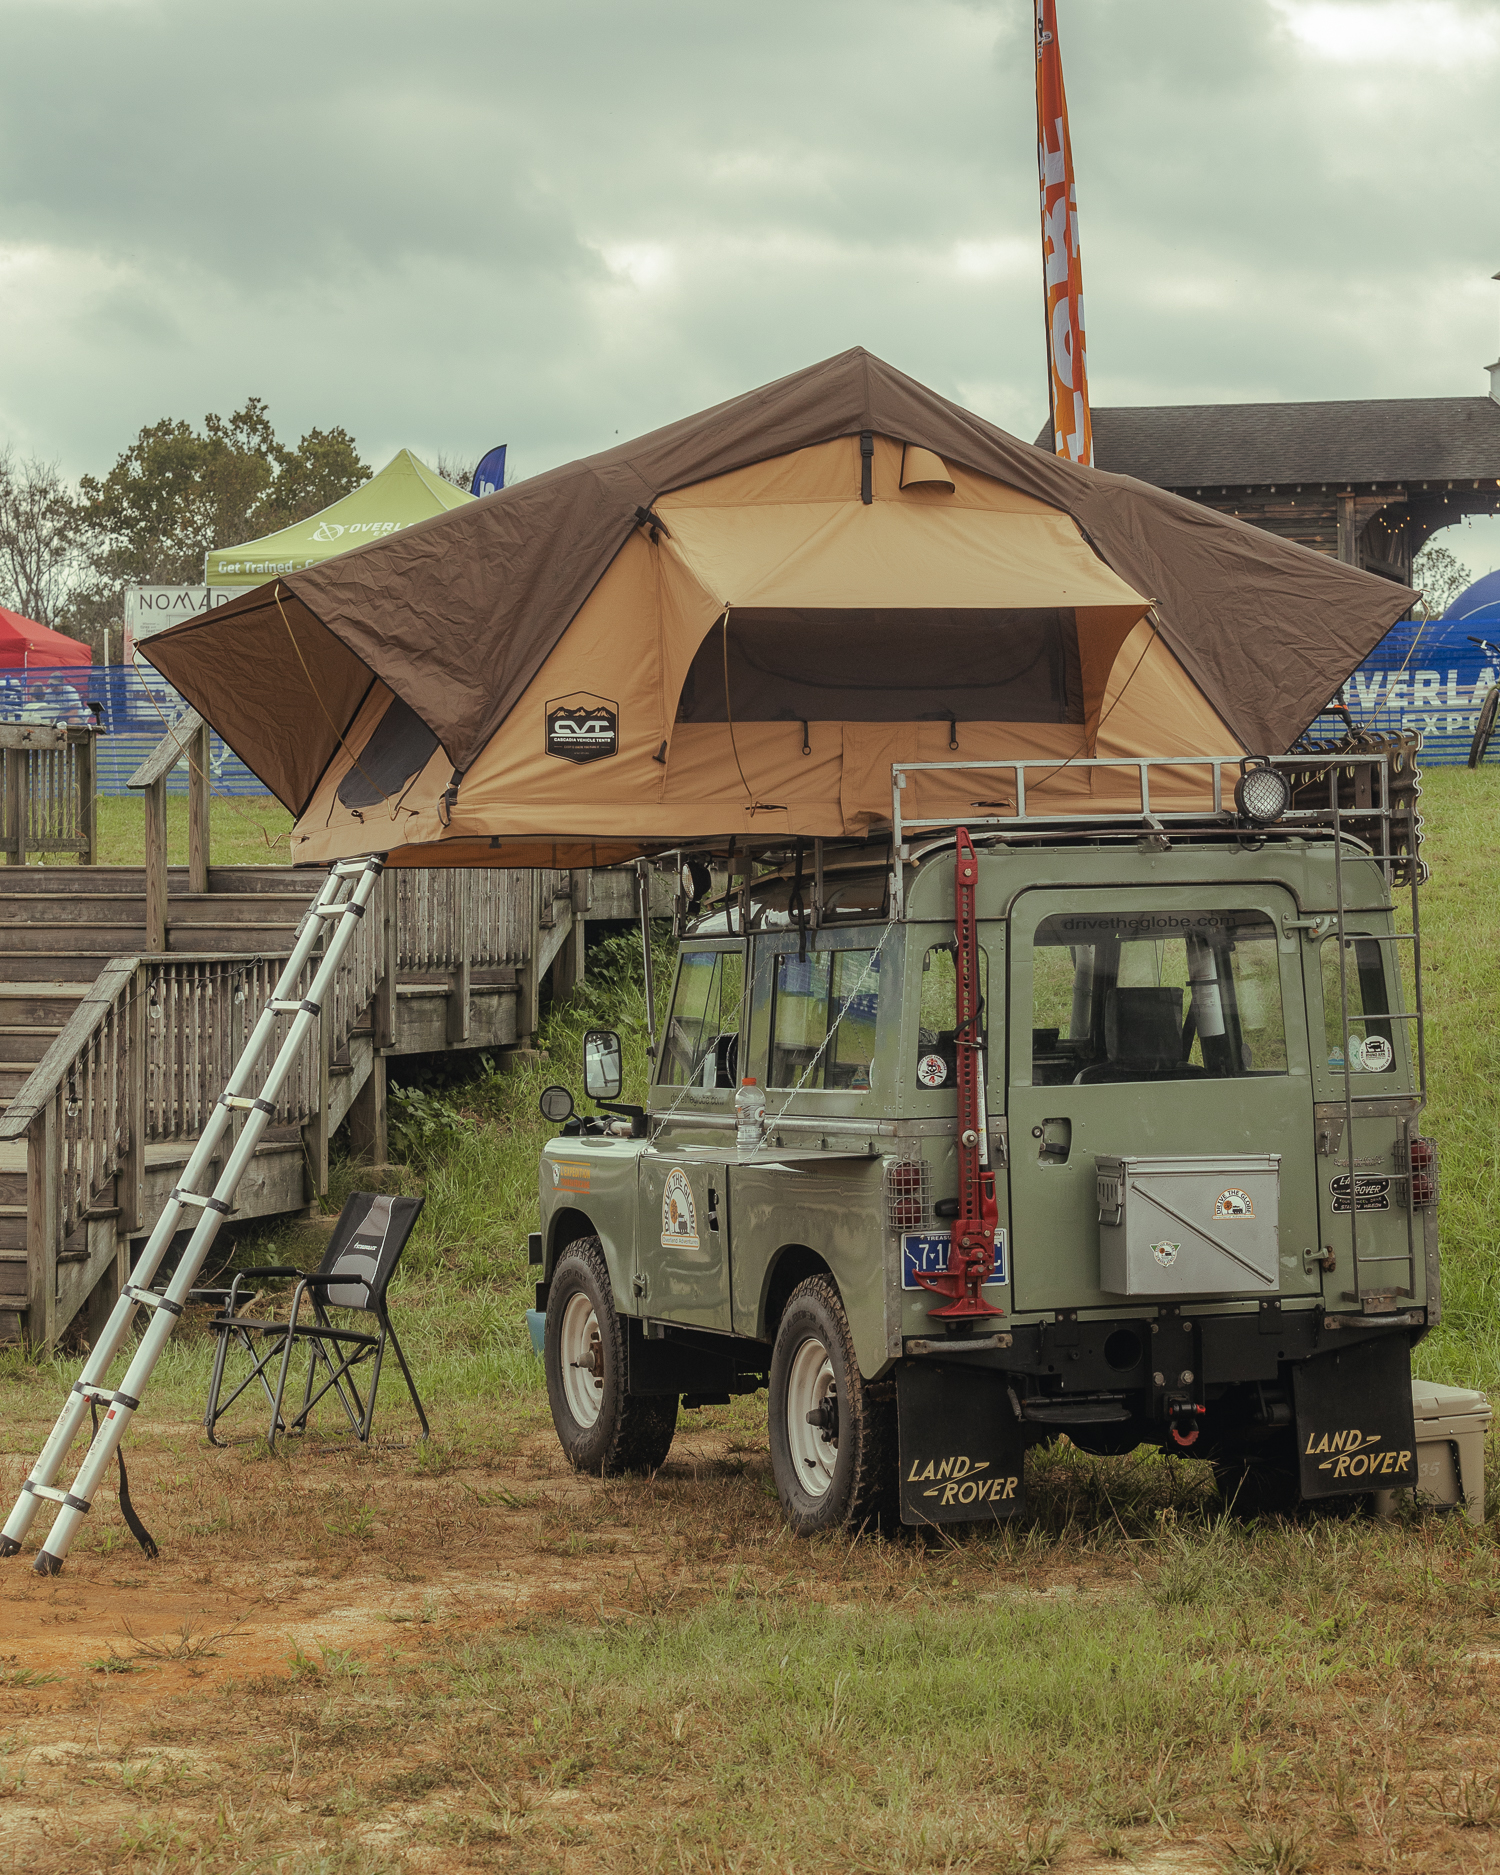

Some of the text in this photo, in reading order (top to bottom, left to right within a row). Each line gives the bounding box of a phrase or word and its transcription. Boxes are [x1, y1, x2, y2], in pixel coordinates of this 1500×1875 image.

[349, 522, 414, 534] OVERL
[218, 561, 241, 573] Get
[244, 560, 293, 573] Trained
[554, 720, 609, 734] CVT
[1064, 915, 1236, 931] drivetheglobe.com
[672, 1173, 684, 1188] THE
[1304, 1429, 1363, 1455] LAND
[907, 1456, 971, 1482] LAND
[1332, 1450, 1412, 1478] ROVER
[940, 1476, 1019, 1506] ROVER
